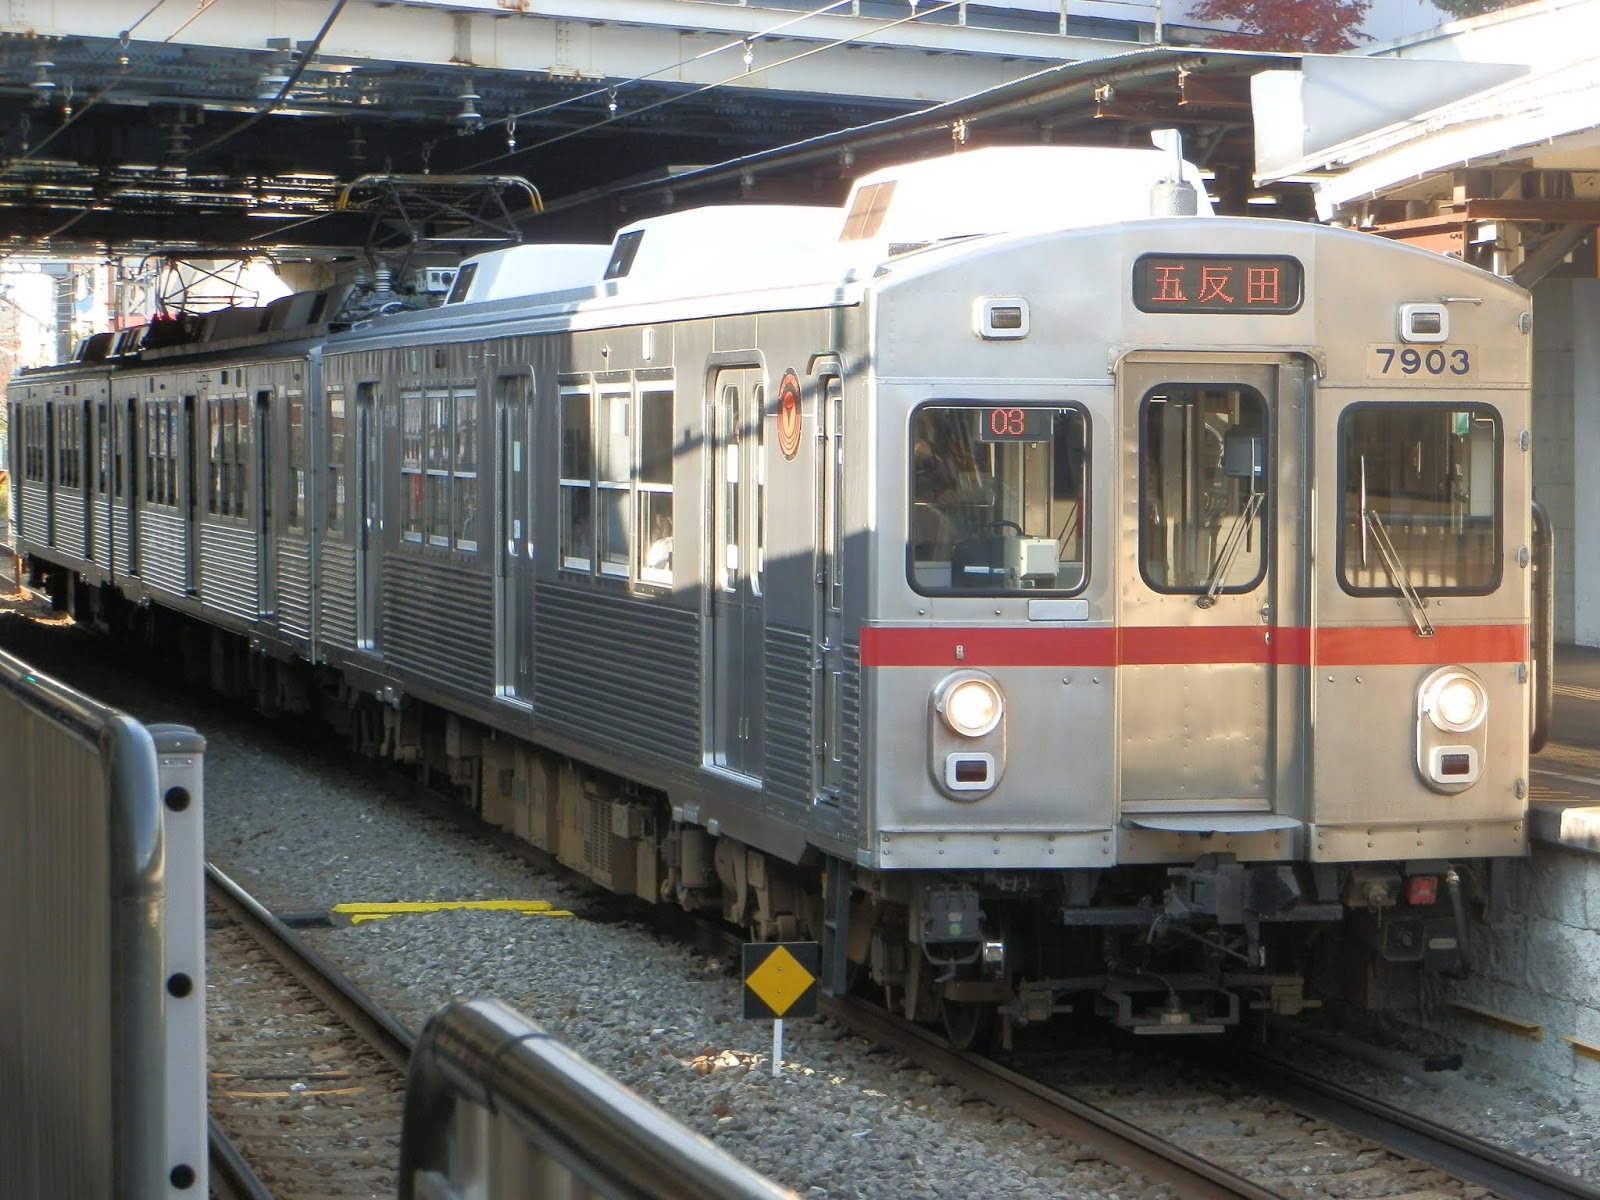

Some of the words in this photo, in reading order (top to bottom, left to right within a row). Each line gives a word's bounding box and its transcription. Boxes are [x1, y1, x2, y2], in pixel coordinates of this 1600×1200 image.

[1151, 265, 1280, 304] 五反田
[1376, 347, 1471, 376] 7903
[990, 408, 1025, 436] 03
